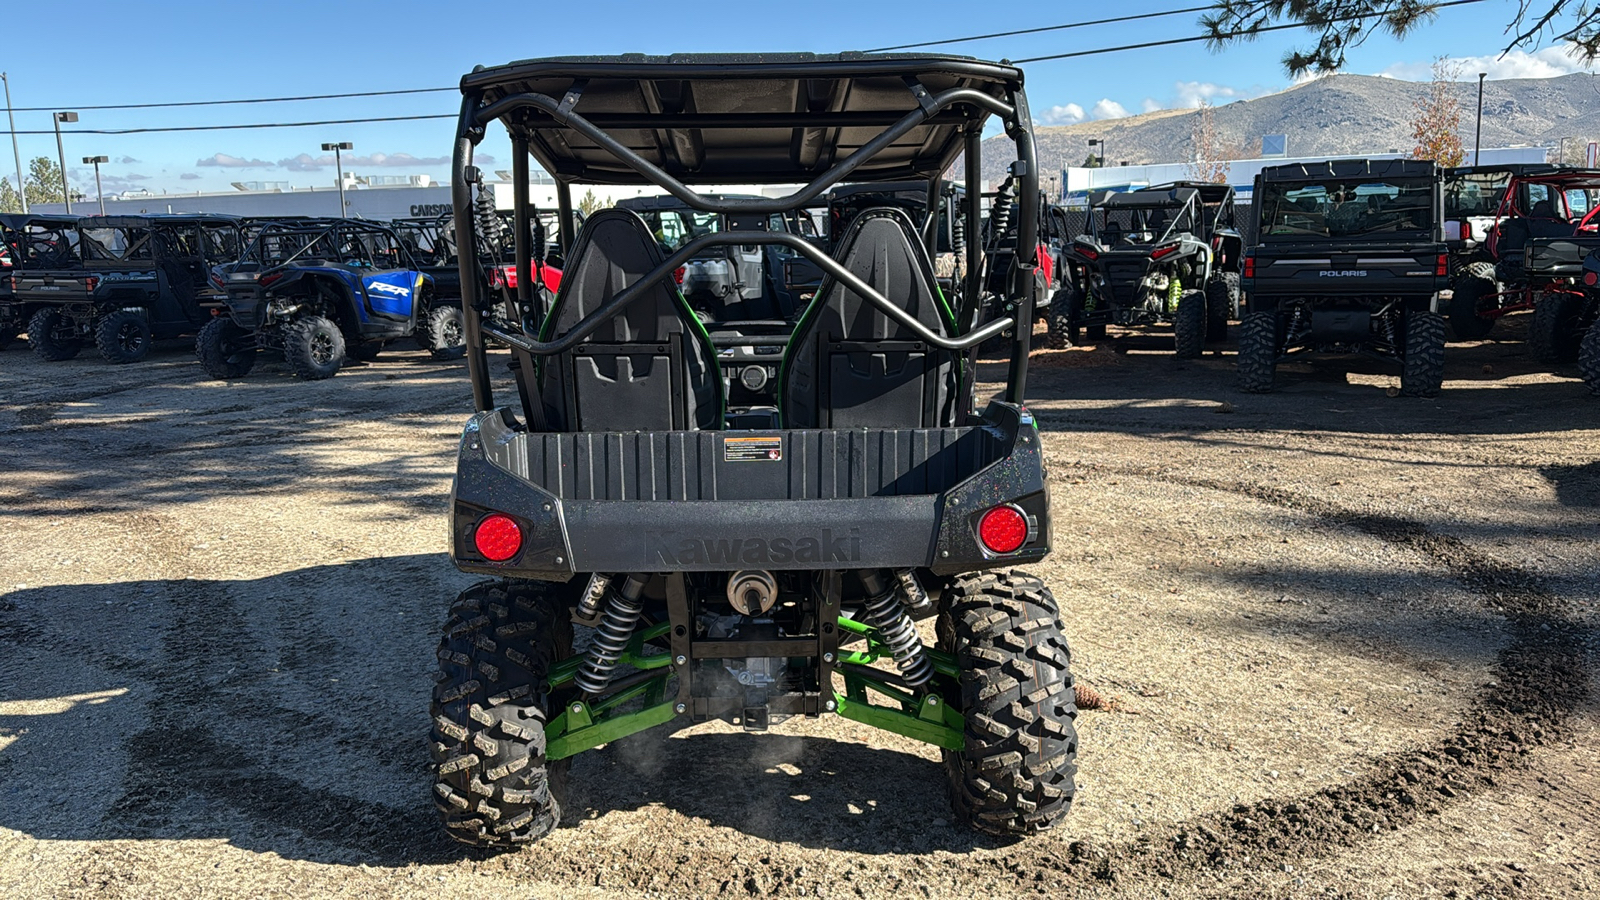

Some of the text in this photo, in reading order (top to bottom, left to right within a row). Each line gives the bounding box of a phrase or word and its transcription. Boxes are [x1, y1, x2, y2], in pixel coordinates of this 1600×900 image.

[367, 281, 410, 297] RZR
[645, 528, 861, 565] Kawasaki
[584, 577, 604, 606] FOX
[901, 572, 923, 601] FOX
